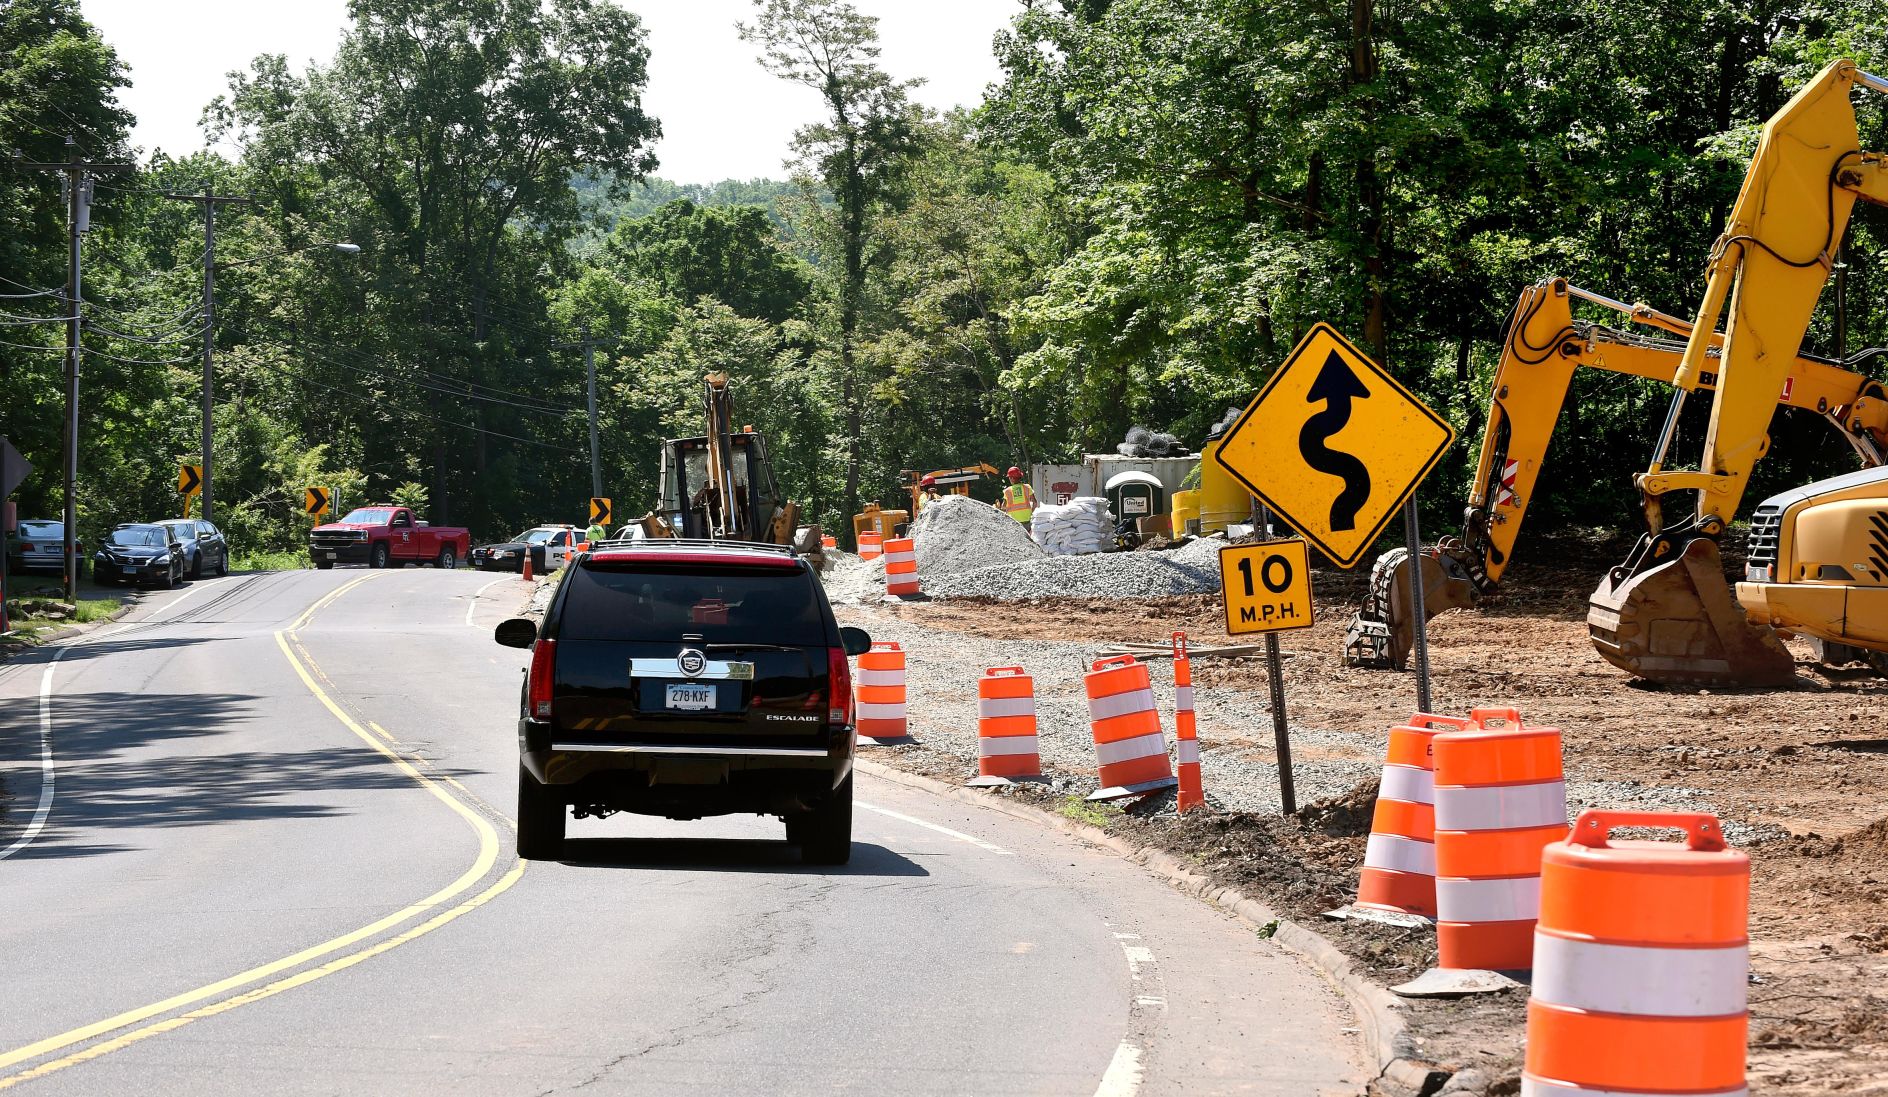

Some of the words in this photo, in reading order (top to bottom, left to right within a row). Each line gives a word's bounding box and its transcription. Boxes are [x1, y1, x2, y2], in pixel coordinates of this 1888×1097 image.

[1238, 554, 1293, 597] 10
[1240, 602, 1300, 623] M.P.H.
[766, 714, 819, 722] ESCALADE
